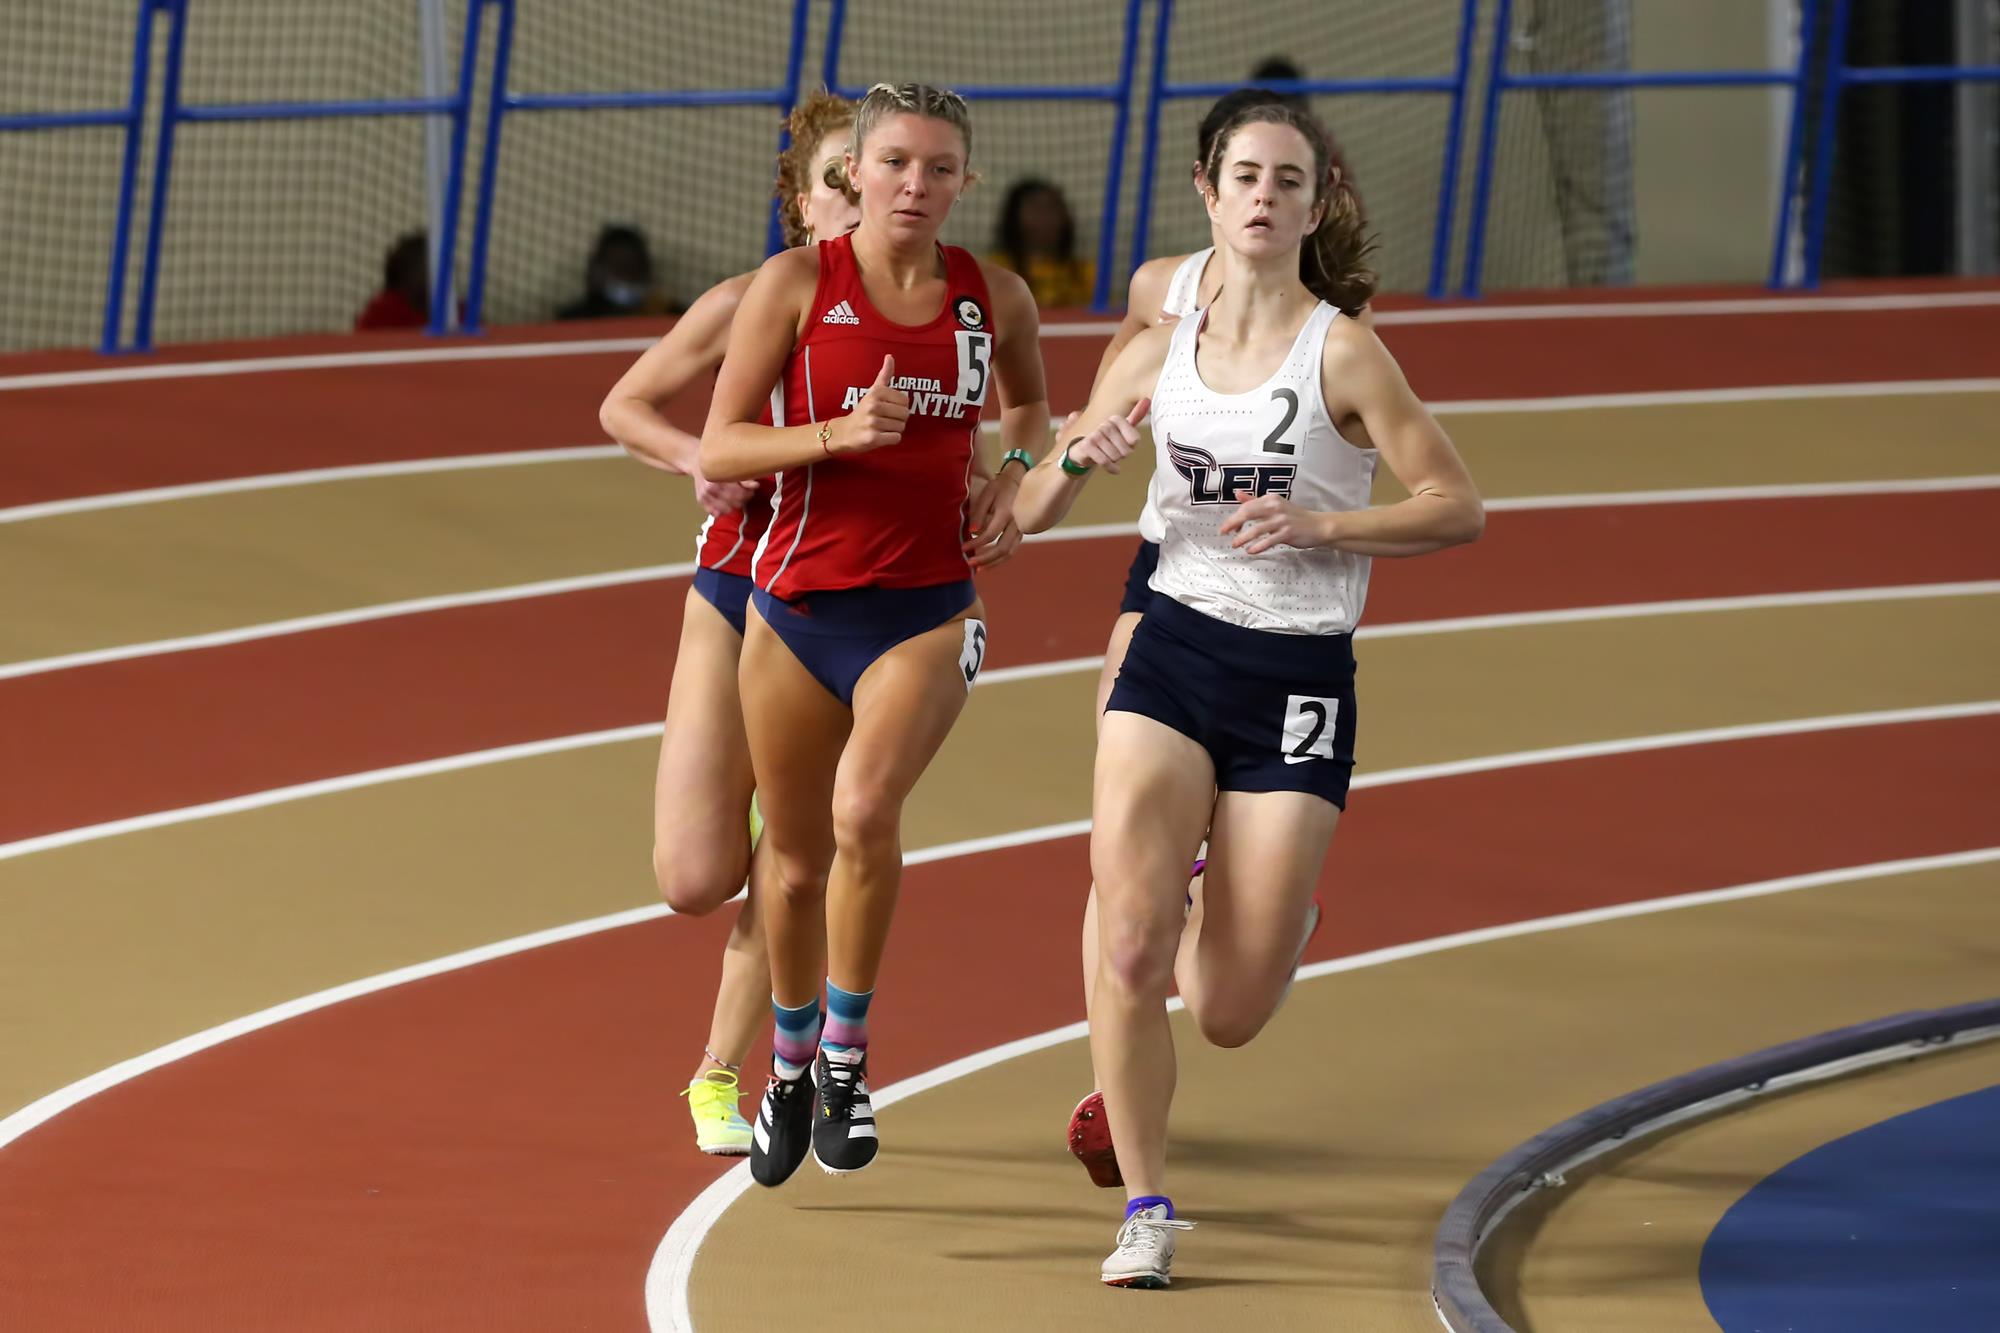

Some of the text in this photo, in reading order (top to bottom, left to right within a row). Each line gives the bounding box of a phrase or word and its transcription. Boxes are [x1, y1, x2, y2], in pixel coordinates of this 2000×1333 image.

[823, 313, 860, 325] adidas
[888, 376, 941, 393] LORIDA
[966, 335, 986, 402] 5
[1262, 387, 1299, 456] 2
[1190, 464, 1298, 506] LEE
[965, 623, 986, 682] 5
[1293, 700, 1327, 758] 2
